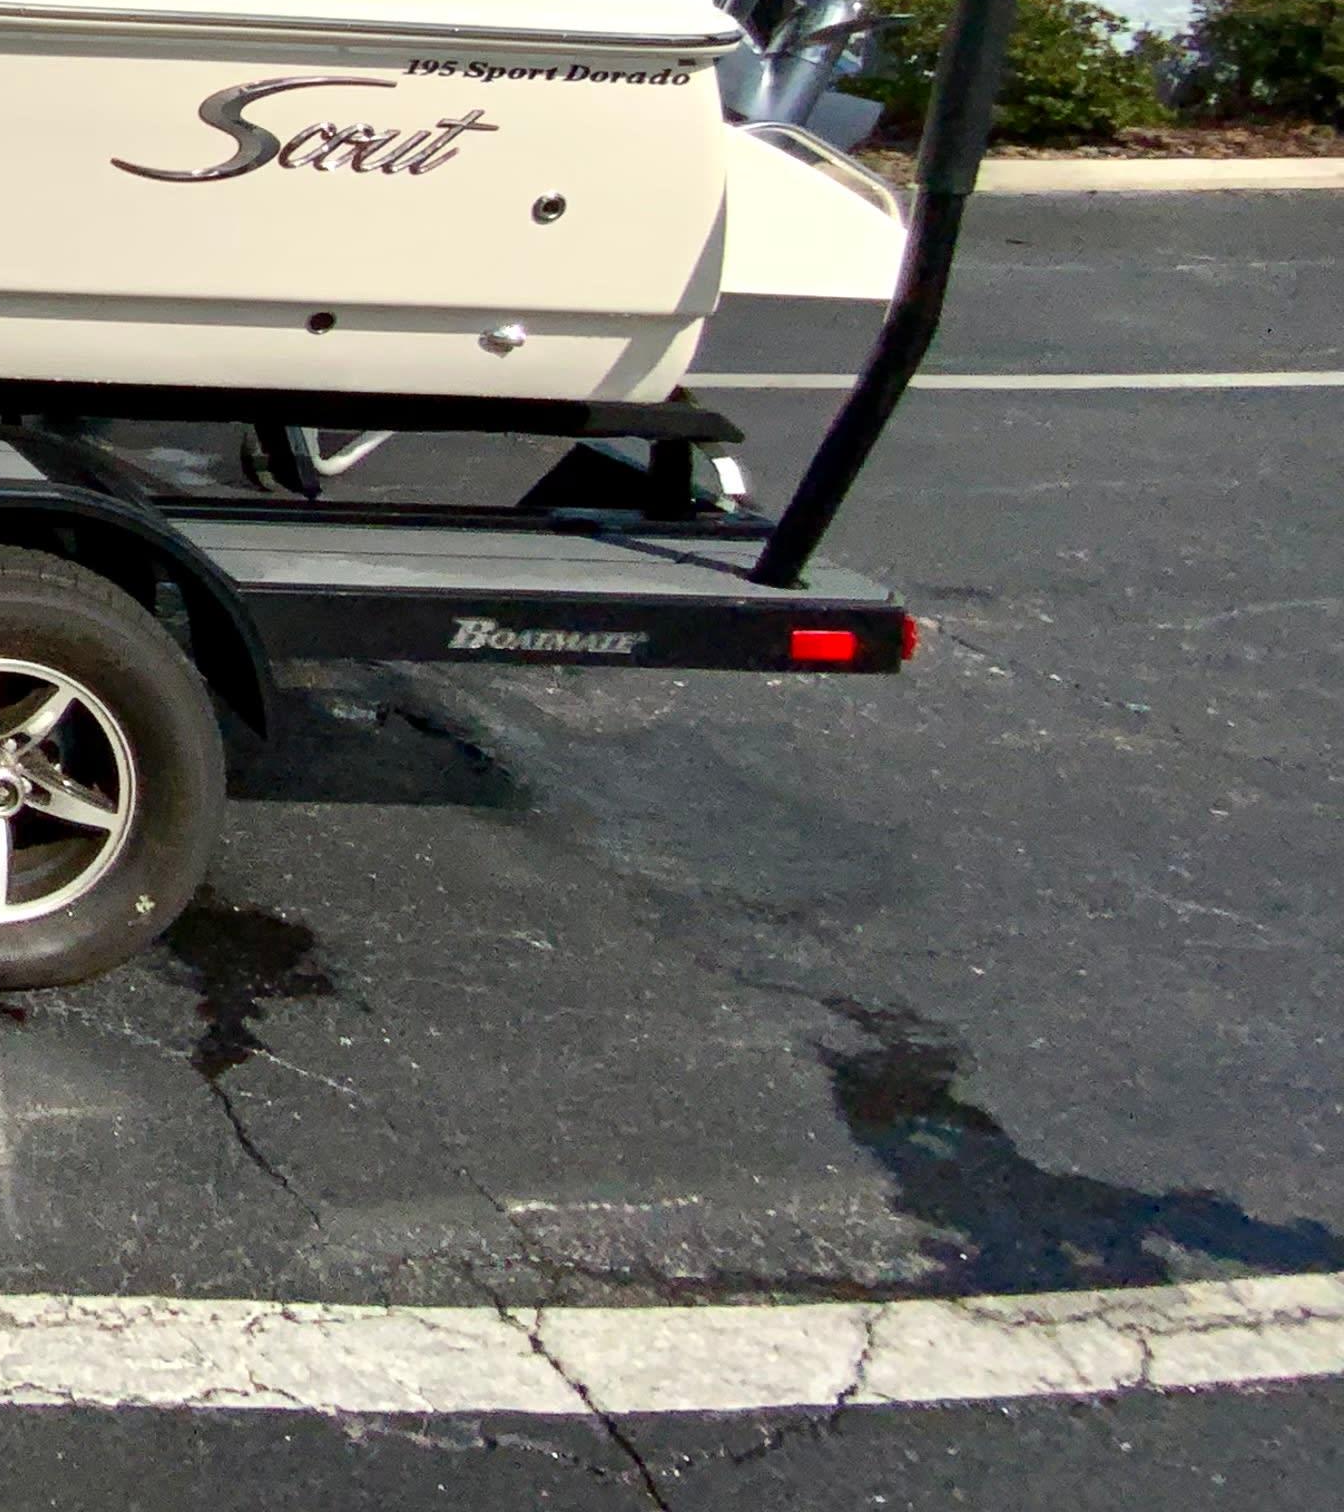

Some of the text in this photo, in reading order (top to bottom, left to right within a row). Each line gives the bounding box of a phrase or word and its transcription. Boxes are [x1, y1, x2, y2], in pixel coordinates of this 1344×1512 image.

[405, 60, 691, 86] 195 Sport Dorado
[110, 76, 499, 183] Scout
